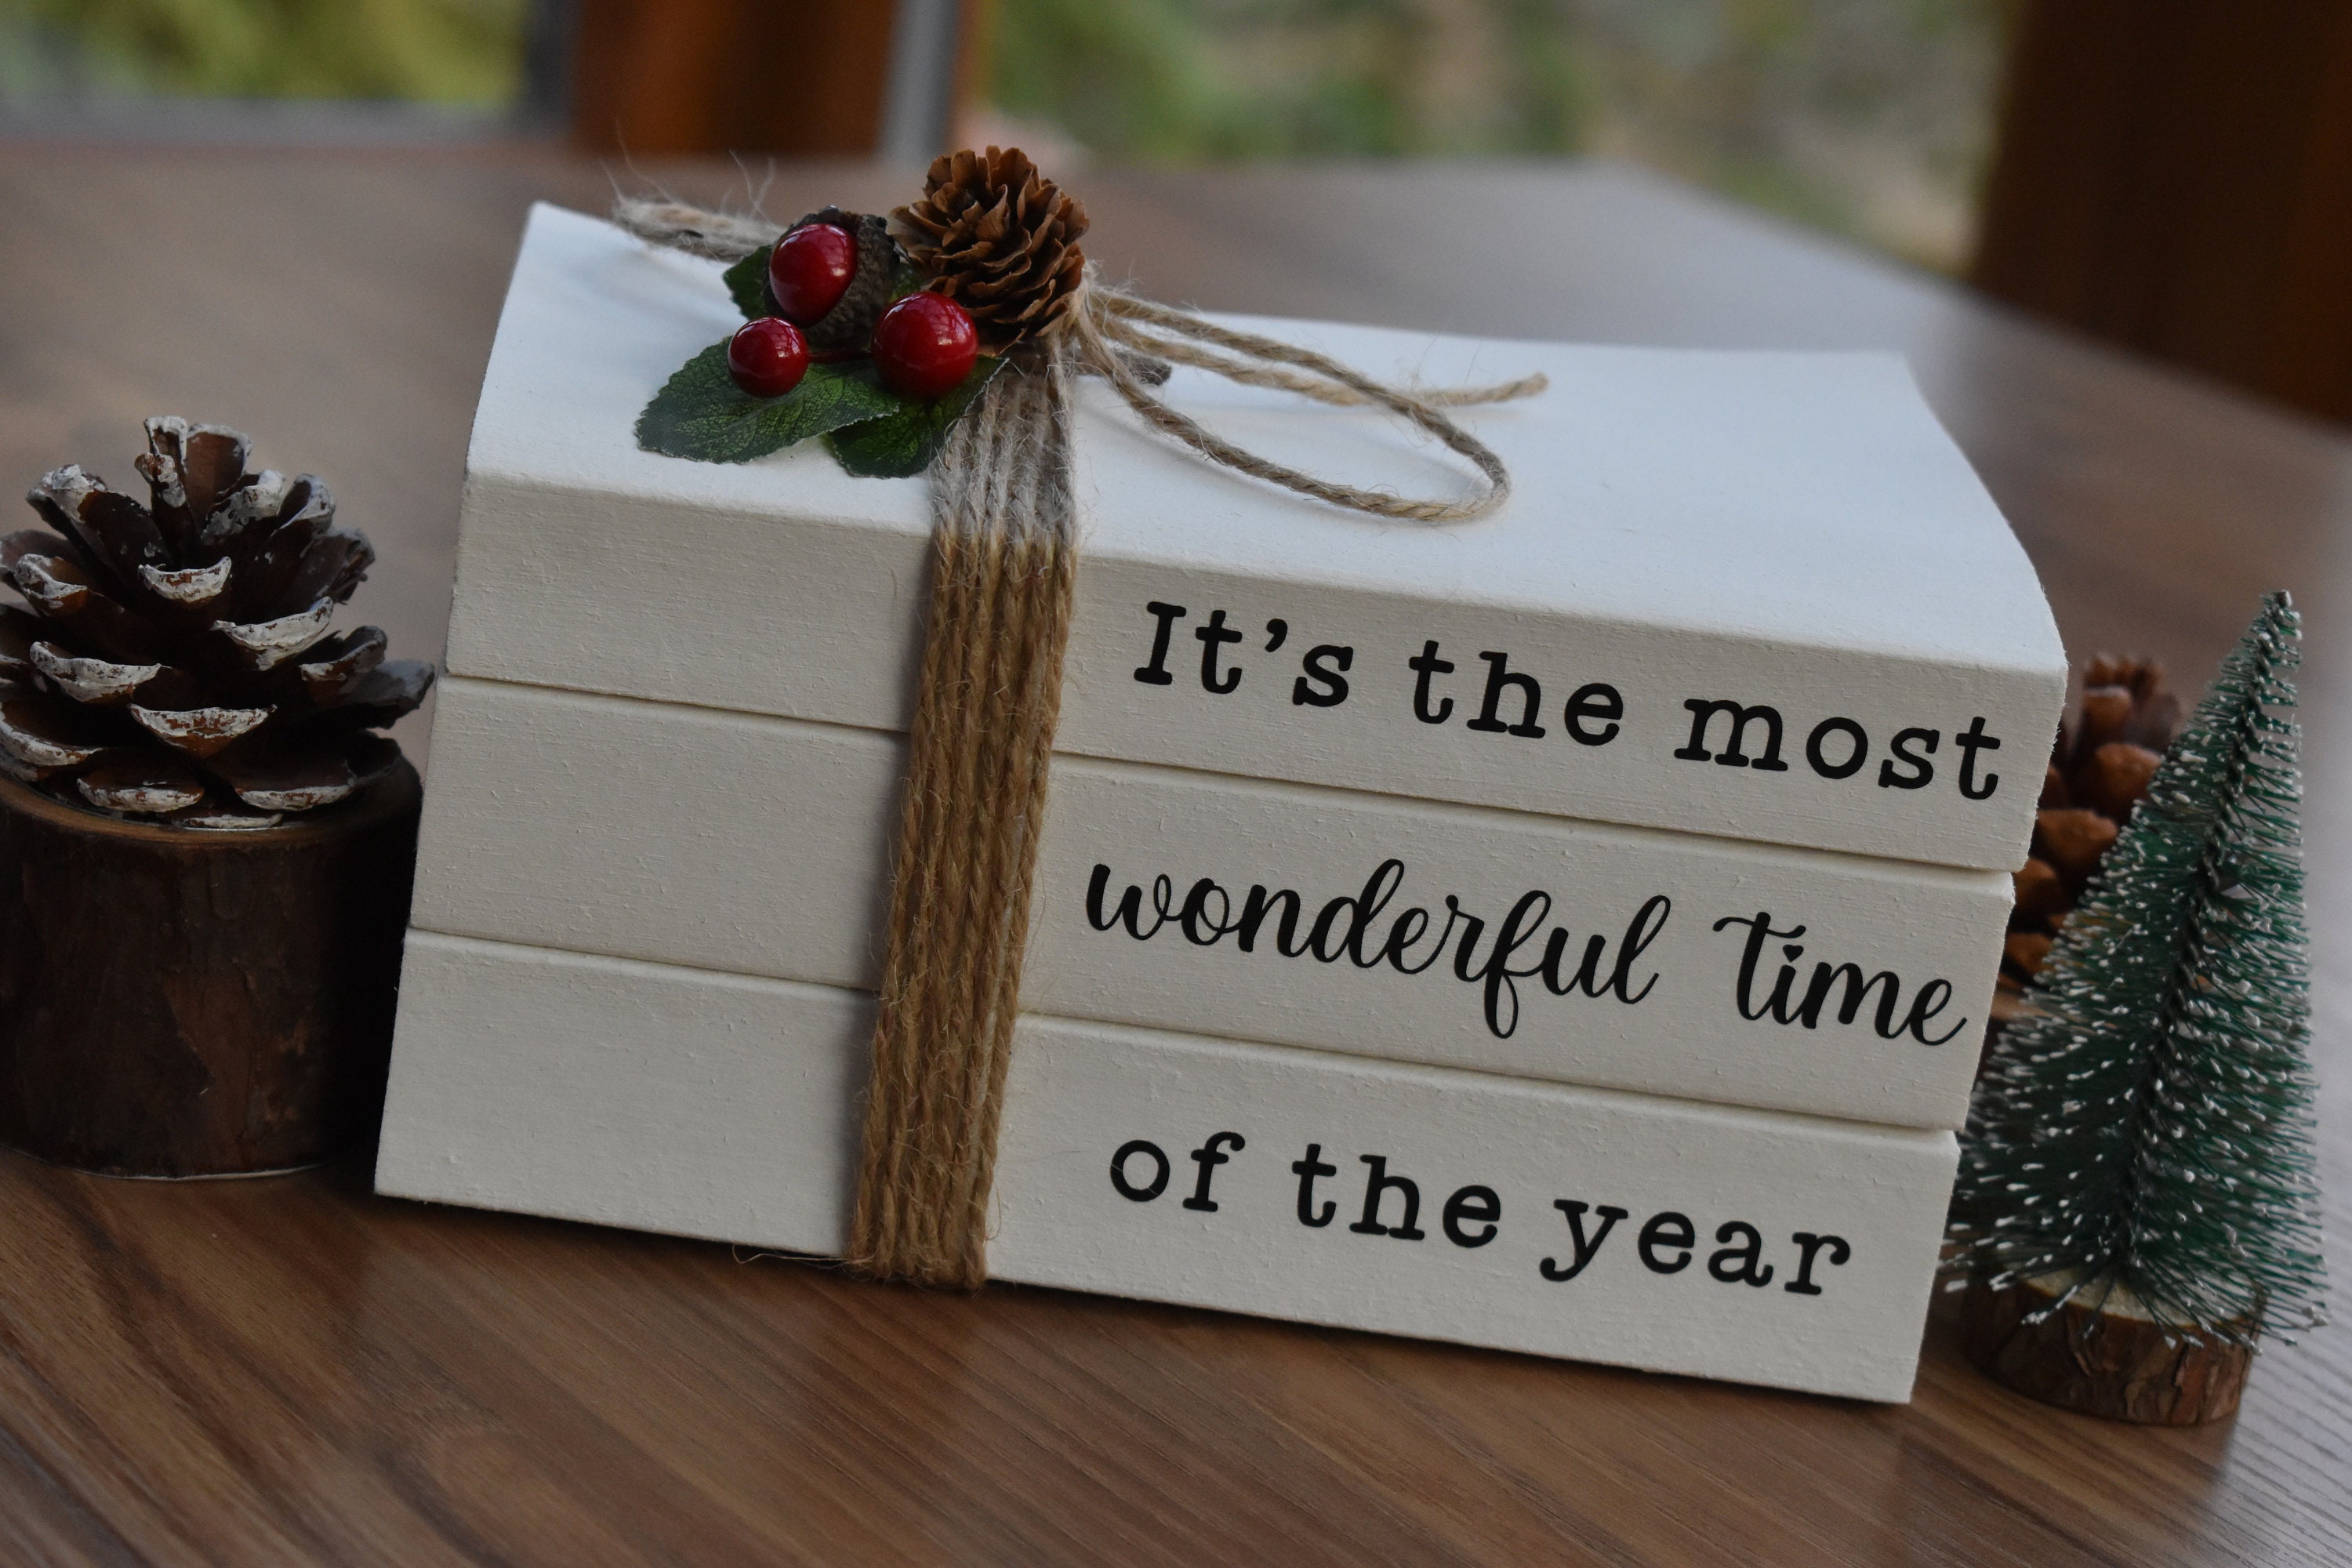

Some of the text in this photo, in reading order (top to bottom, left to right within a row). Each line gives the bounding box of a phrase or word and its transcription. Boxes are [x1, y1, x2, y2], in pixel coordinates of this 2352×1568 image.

[1407, 638, 1625, 748] the
[1672, 697, 2002, 801] most
[1084, 857, 1969, 1047] wonderful time
[1109, 1130, 1852, 1297] of the year
